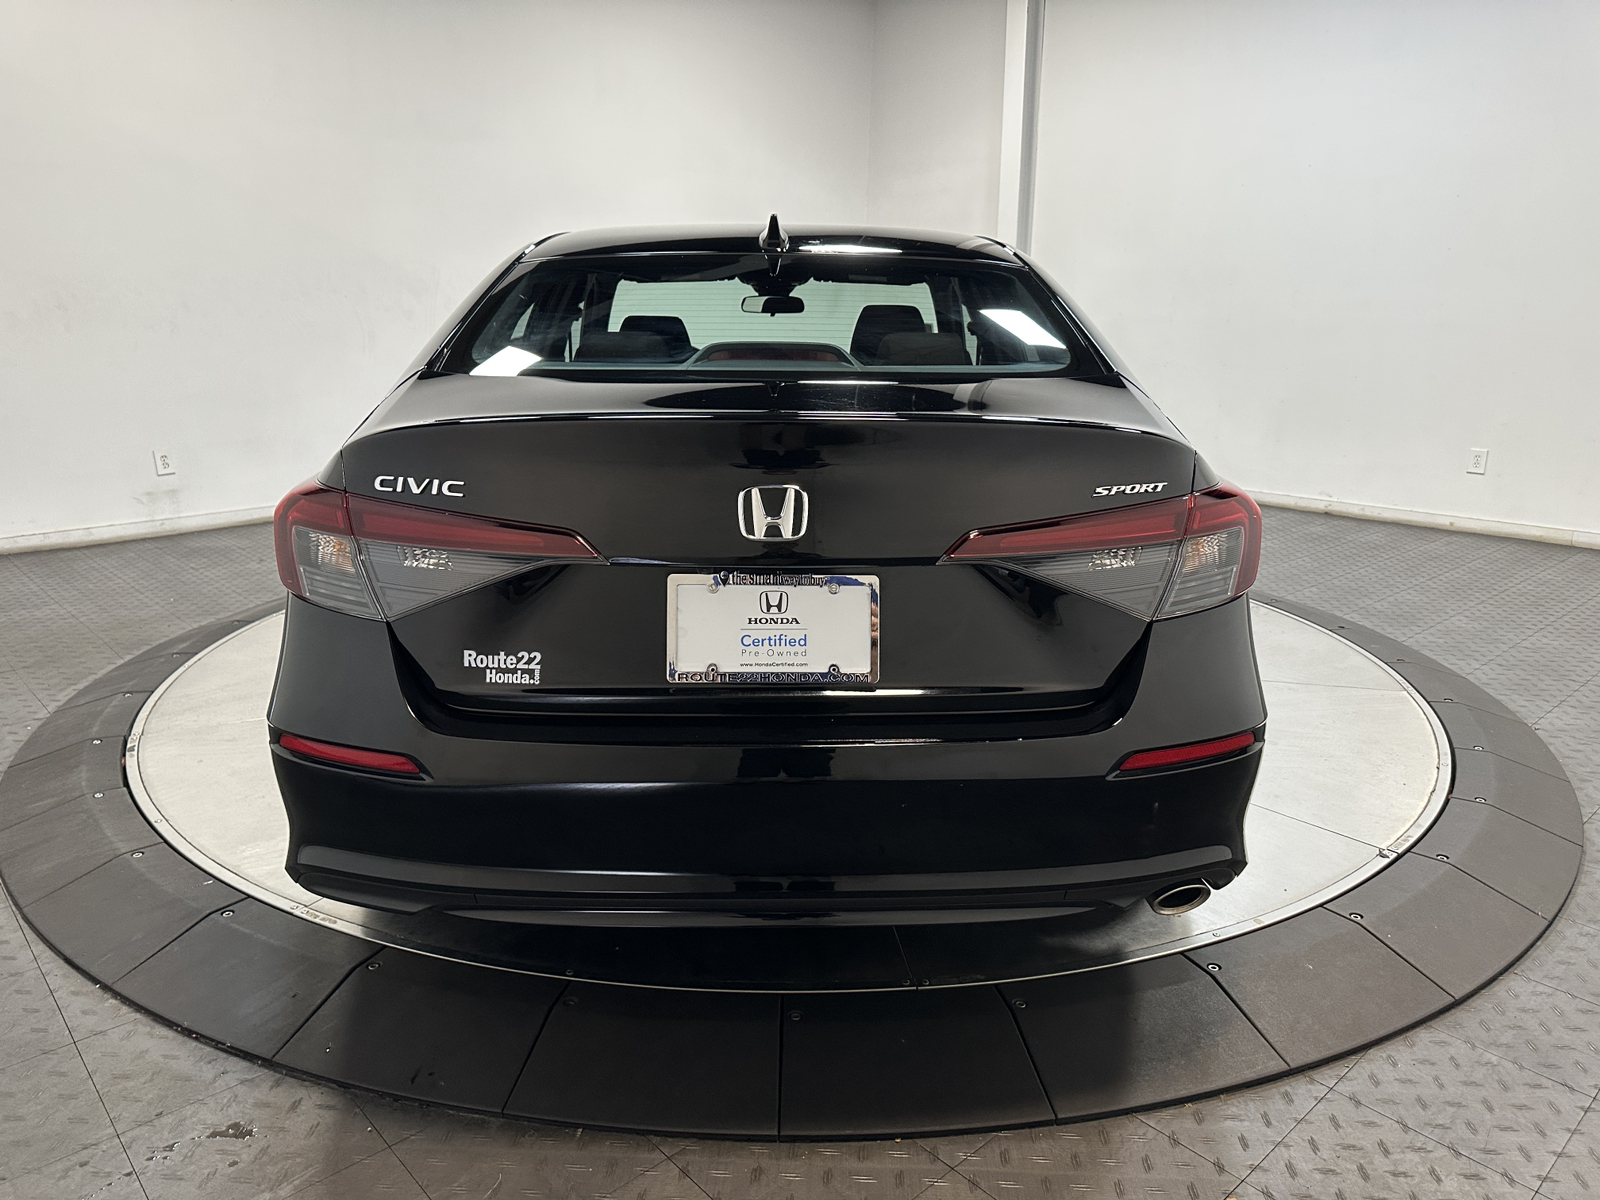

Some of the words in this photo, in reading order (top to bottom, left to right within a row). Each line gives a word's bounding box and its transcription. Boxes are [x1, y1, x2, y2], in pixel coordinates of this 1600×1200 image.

[374, 475, 465, 497] CIVIC
[1091, 482, 1168, 498] SPORT
[747, 617, 801, 625] HONDA
[740, 633, 807, 647] Certified
[463, 649, 542, 669] Route22
[741, 648, 807, 657] Pre-Owned
